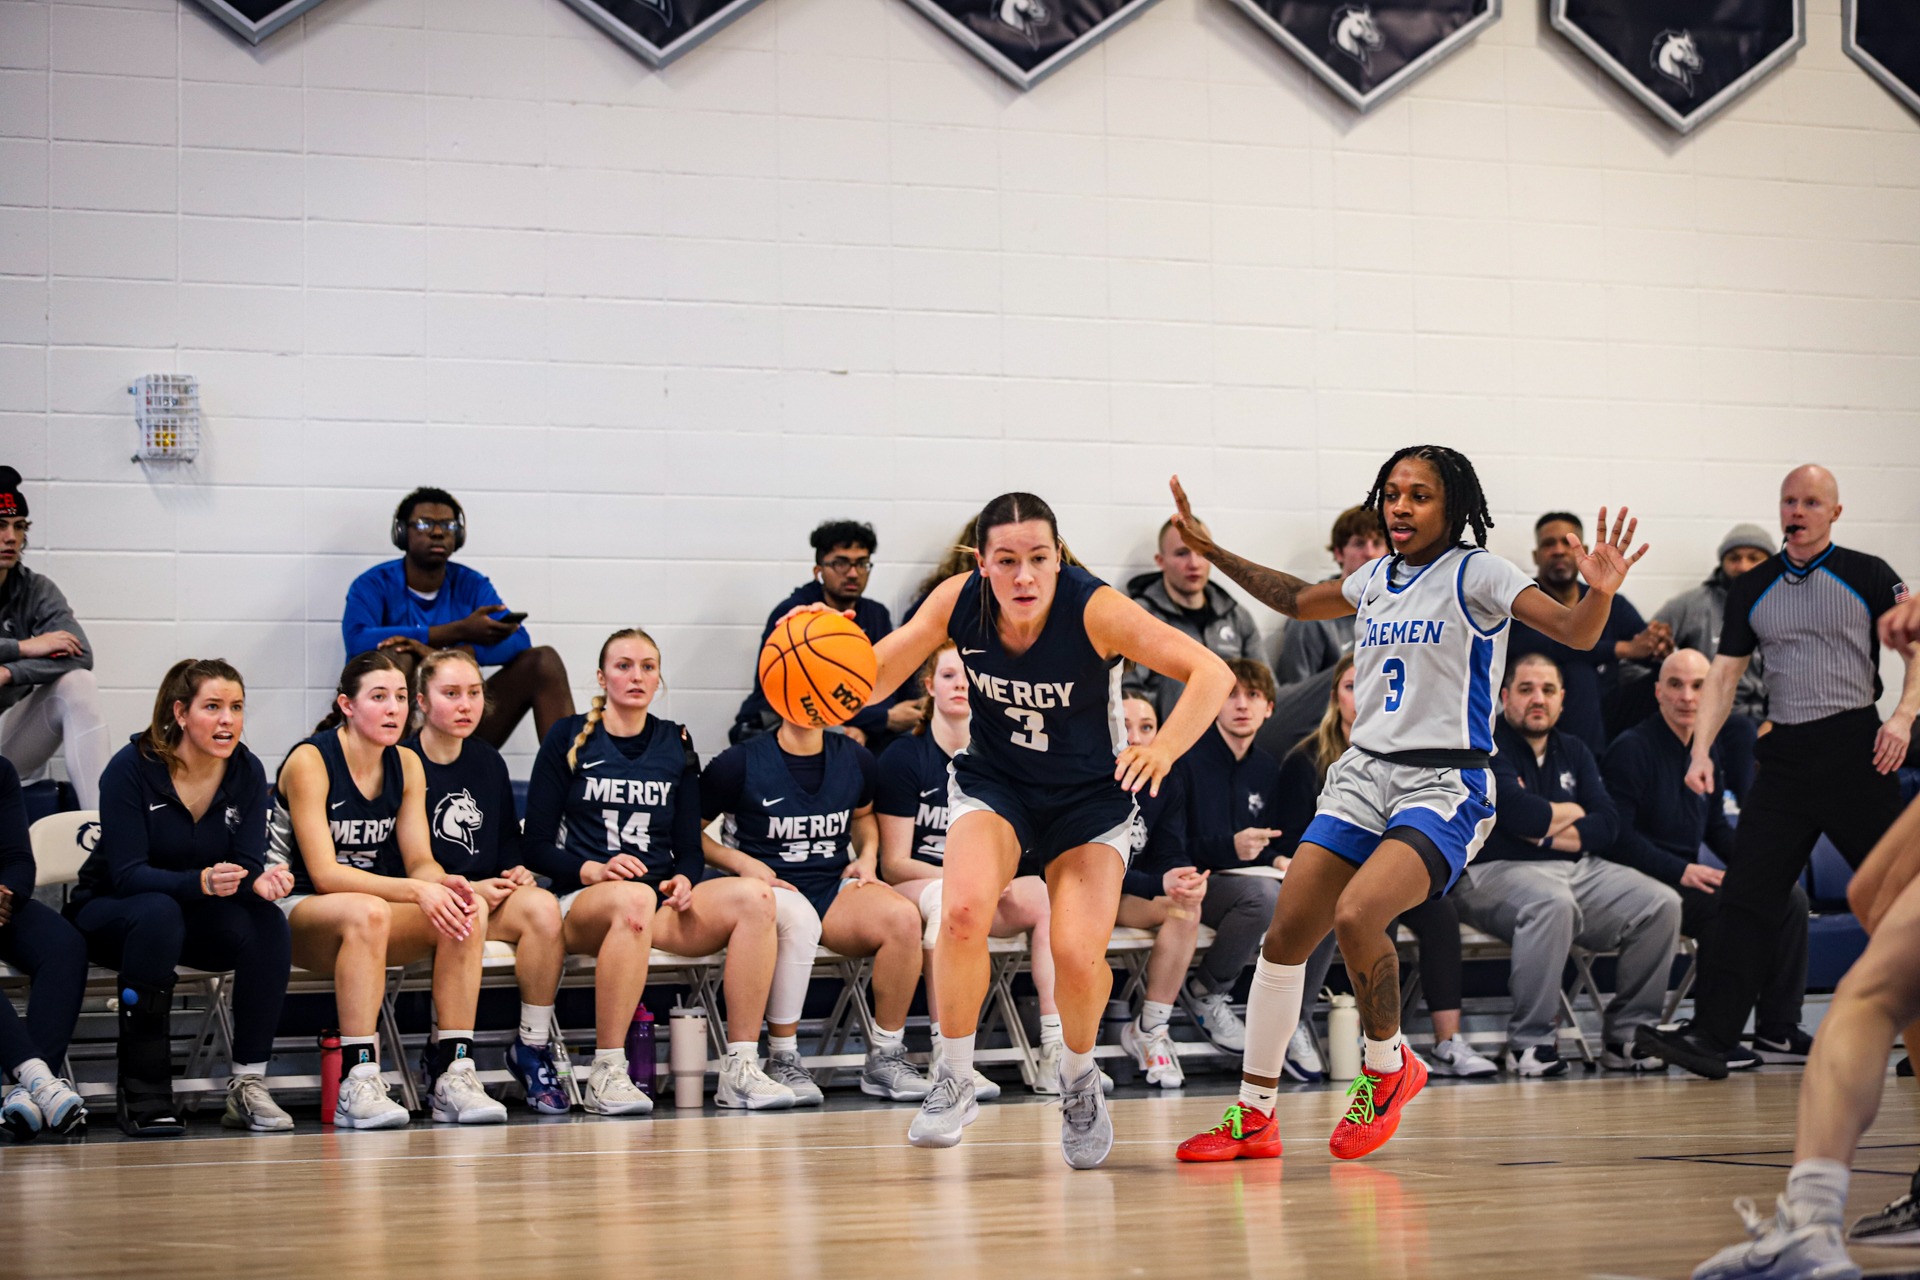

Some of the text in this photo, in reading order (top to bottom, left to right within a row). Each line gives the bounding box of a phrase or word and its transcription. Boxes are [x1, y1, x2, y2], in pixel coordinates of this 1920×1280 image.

[832, 682, 863, 713] CAA
[966, 665, 1075, 709] MERCY
[1381, 657, 1406, 713] 3
[1004, 706, 1049, 752] 3
[582, 776, 672, 806] MERCY
[602, 809, 651, 852] 14
[766, 809, 850, 840] MERCY
